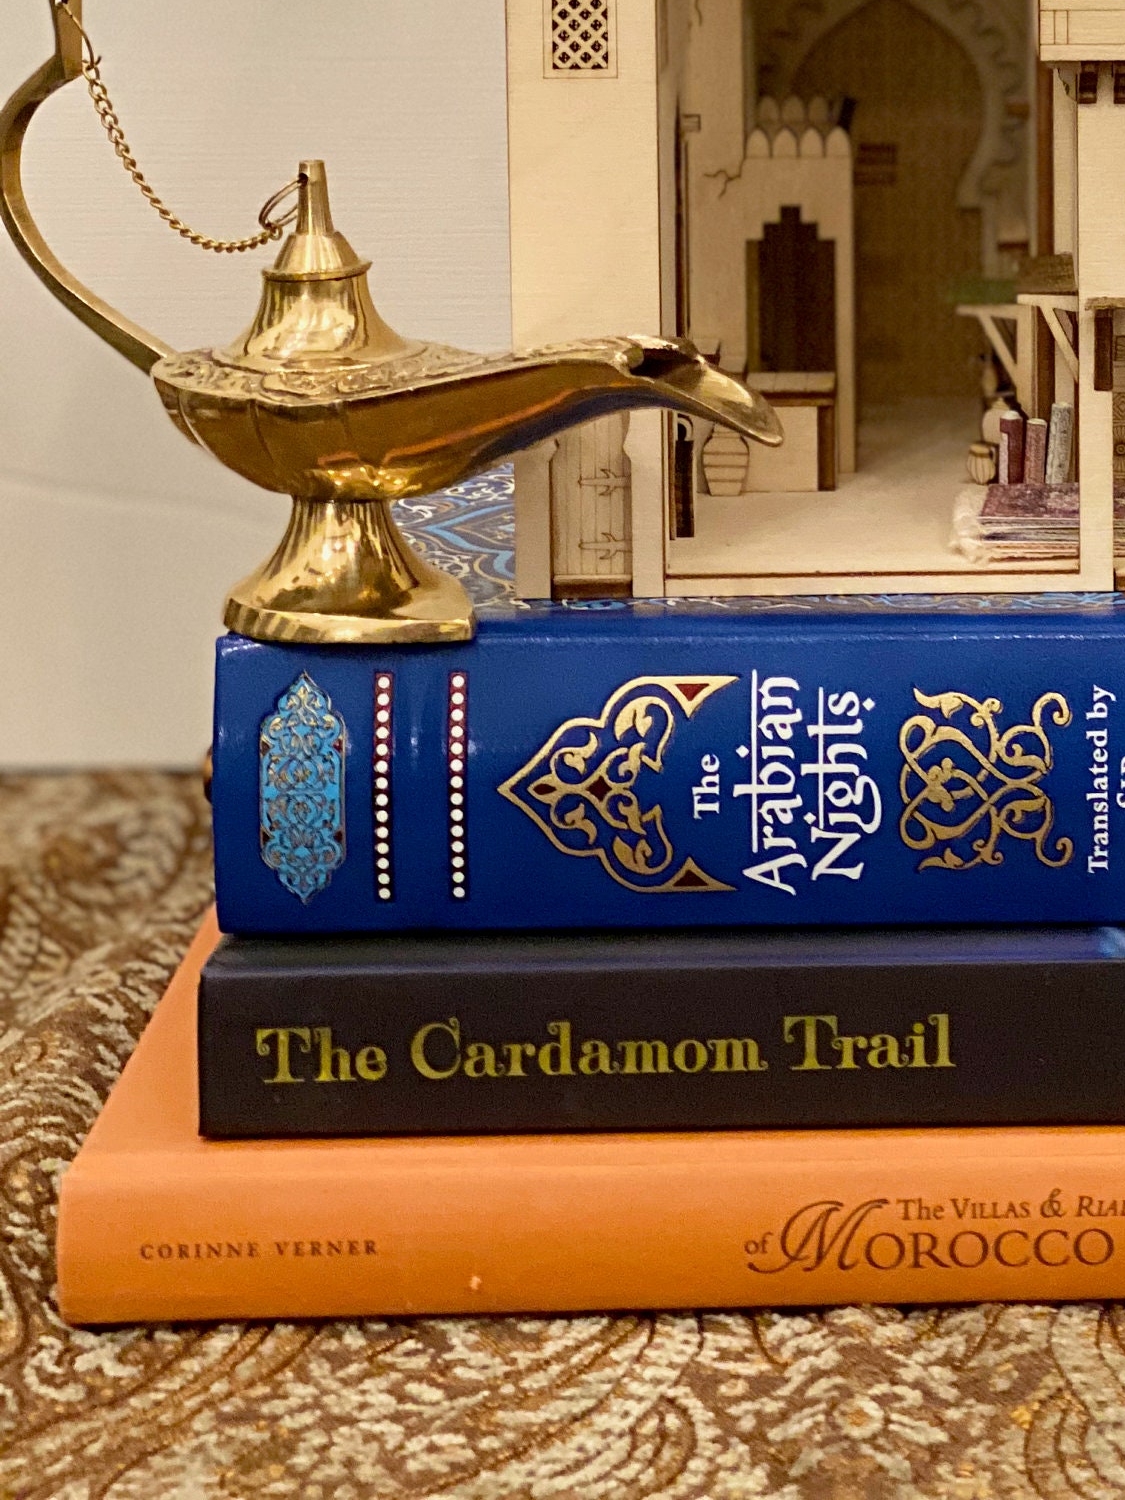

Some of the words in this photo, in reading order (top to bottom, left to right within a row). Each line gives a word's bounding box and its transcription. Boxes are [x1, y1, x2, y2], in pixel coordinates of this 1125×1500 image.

[1086, 684, 1116, 720] by
[692, 753, 720, 819] The
[733, 669, 807, 896] Arabian
[1086, 729, 1109, 874] Translated
[255, 1026, 387, 1084] The
[410, 1017, 768, 1080] Cardamom
[783, 1014, 957, 1072] Trail
[747, 1198, 1115, 1274] MOROCCO
[896, 1198, 945, 1221] The
[949, 1198, 1030, 1220] VILLAS
[1040, 1188, 1064, 1218] &
[140, 1242, 259, 1260] CORINNE
[274, 1239, 377, 1256] VERNER
[744, 1232, 773, 1255] of
